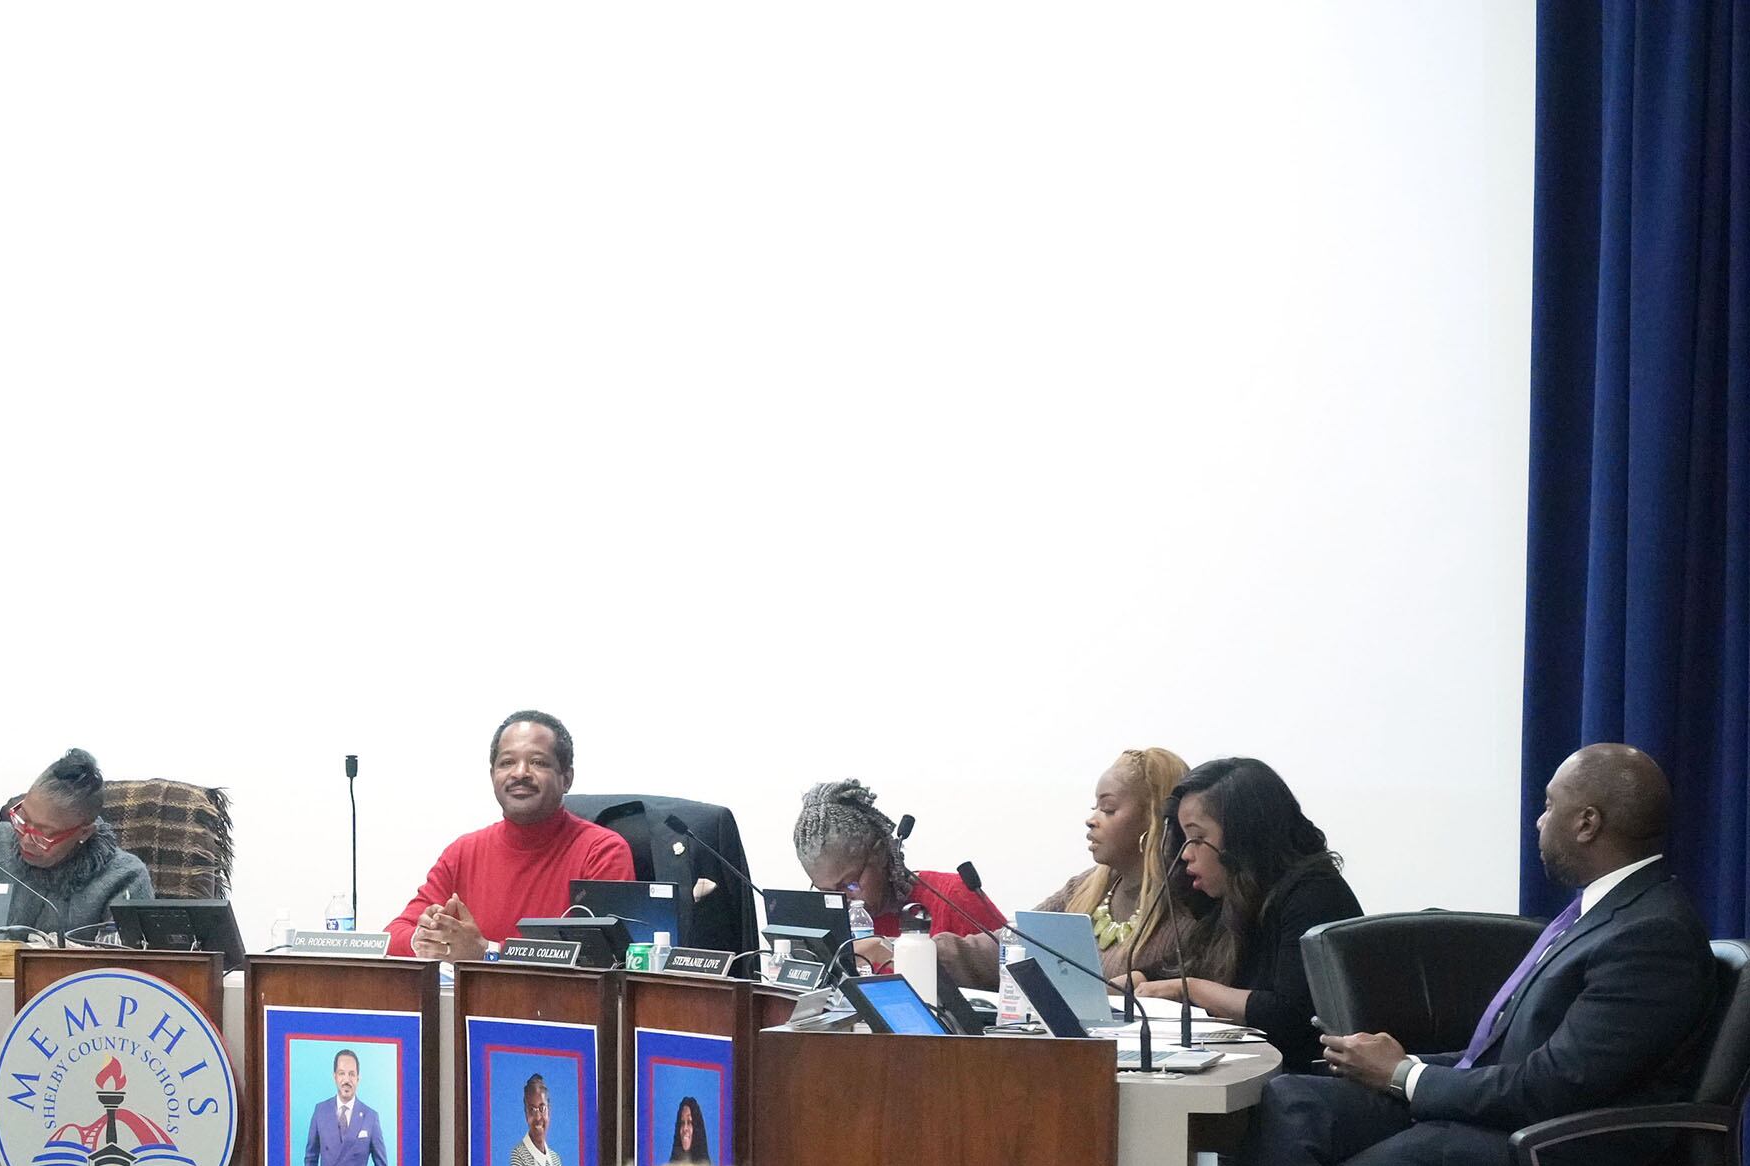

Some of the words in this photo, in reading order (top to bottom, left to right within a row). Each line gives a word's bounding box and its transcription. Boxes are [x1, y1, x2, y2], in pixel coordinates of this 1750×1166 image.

[307, 937, 342, 947] RODERICK
[349, 938, 385, 949] RICHMOND
[504, 946, 529, 957] JOYCE
[536, 948, 571, 959] COLEMAN
[671, 955, 703, 969] STEPHANIE
[703, 957, 721, 969] LOVE
[7, 994, 219, 1118] MEMPHIS
[43, 1058, 69, 1130] SHELBY
[67, 1036, 141, 1064] COUNTY
[140, 1050, 180, 1135] SCHOOLS
